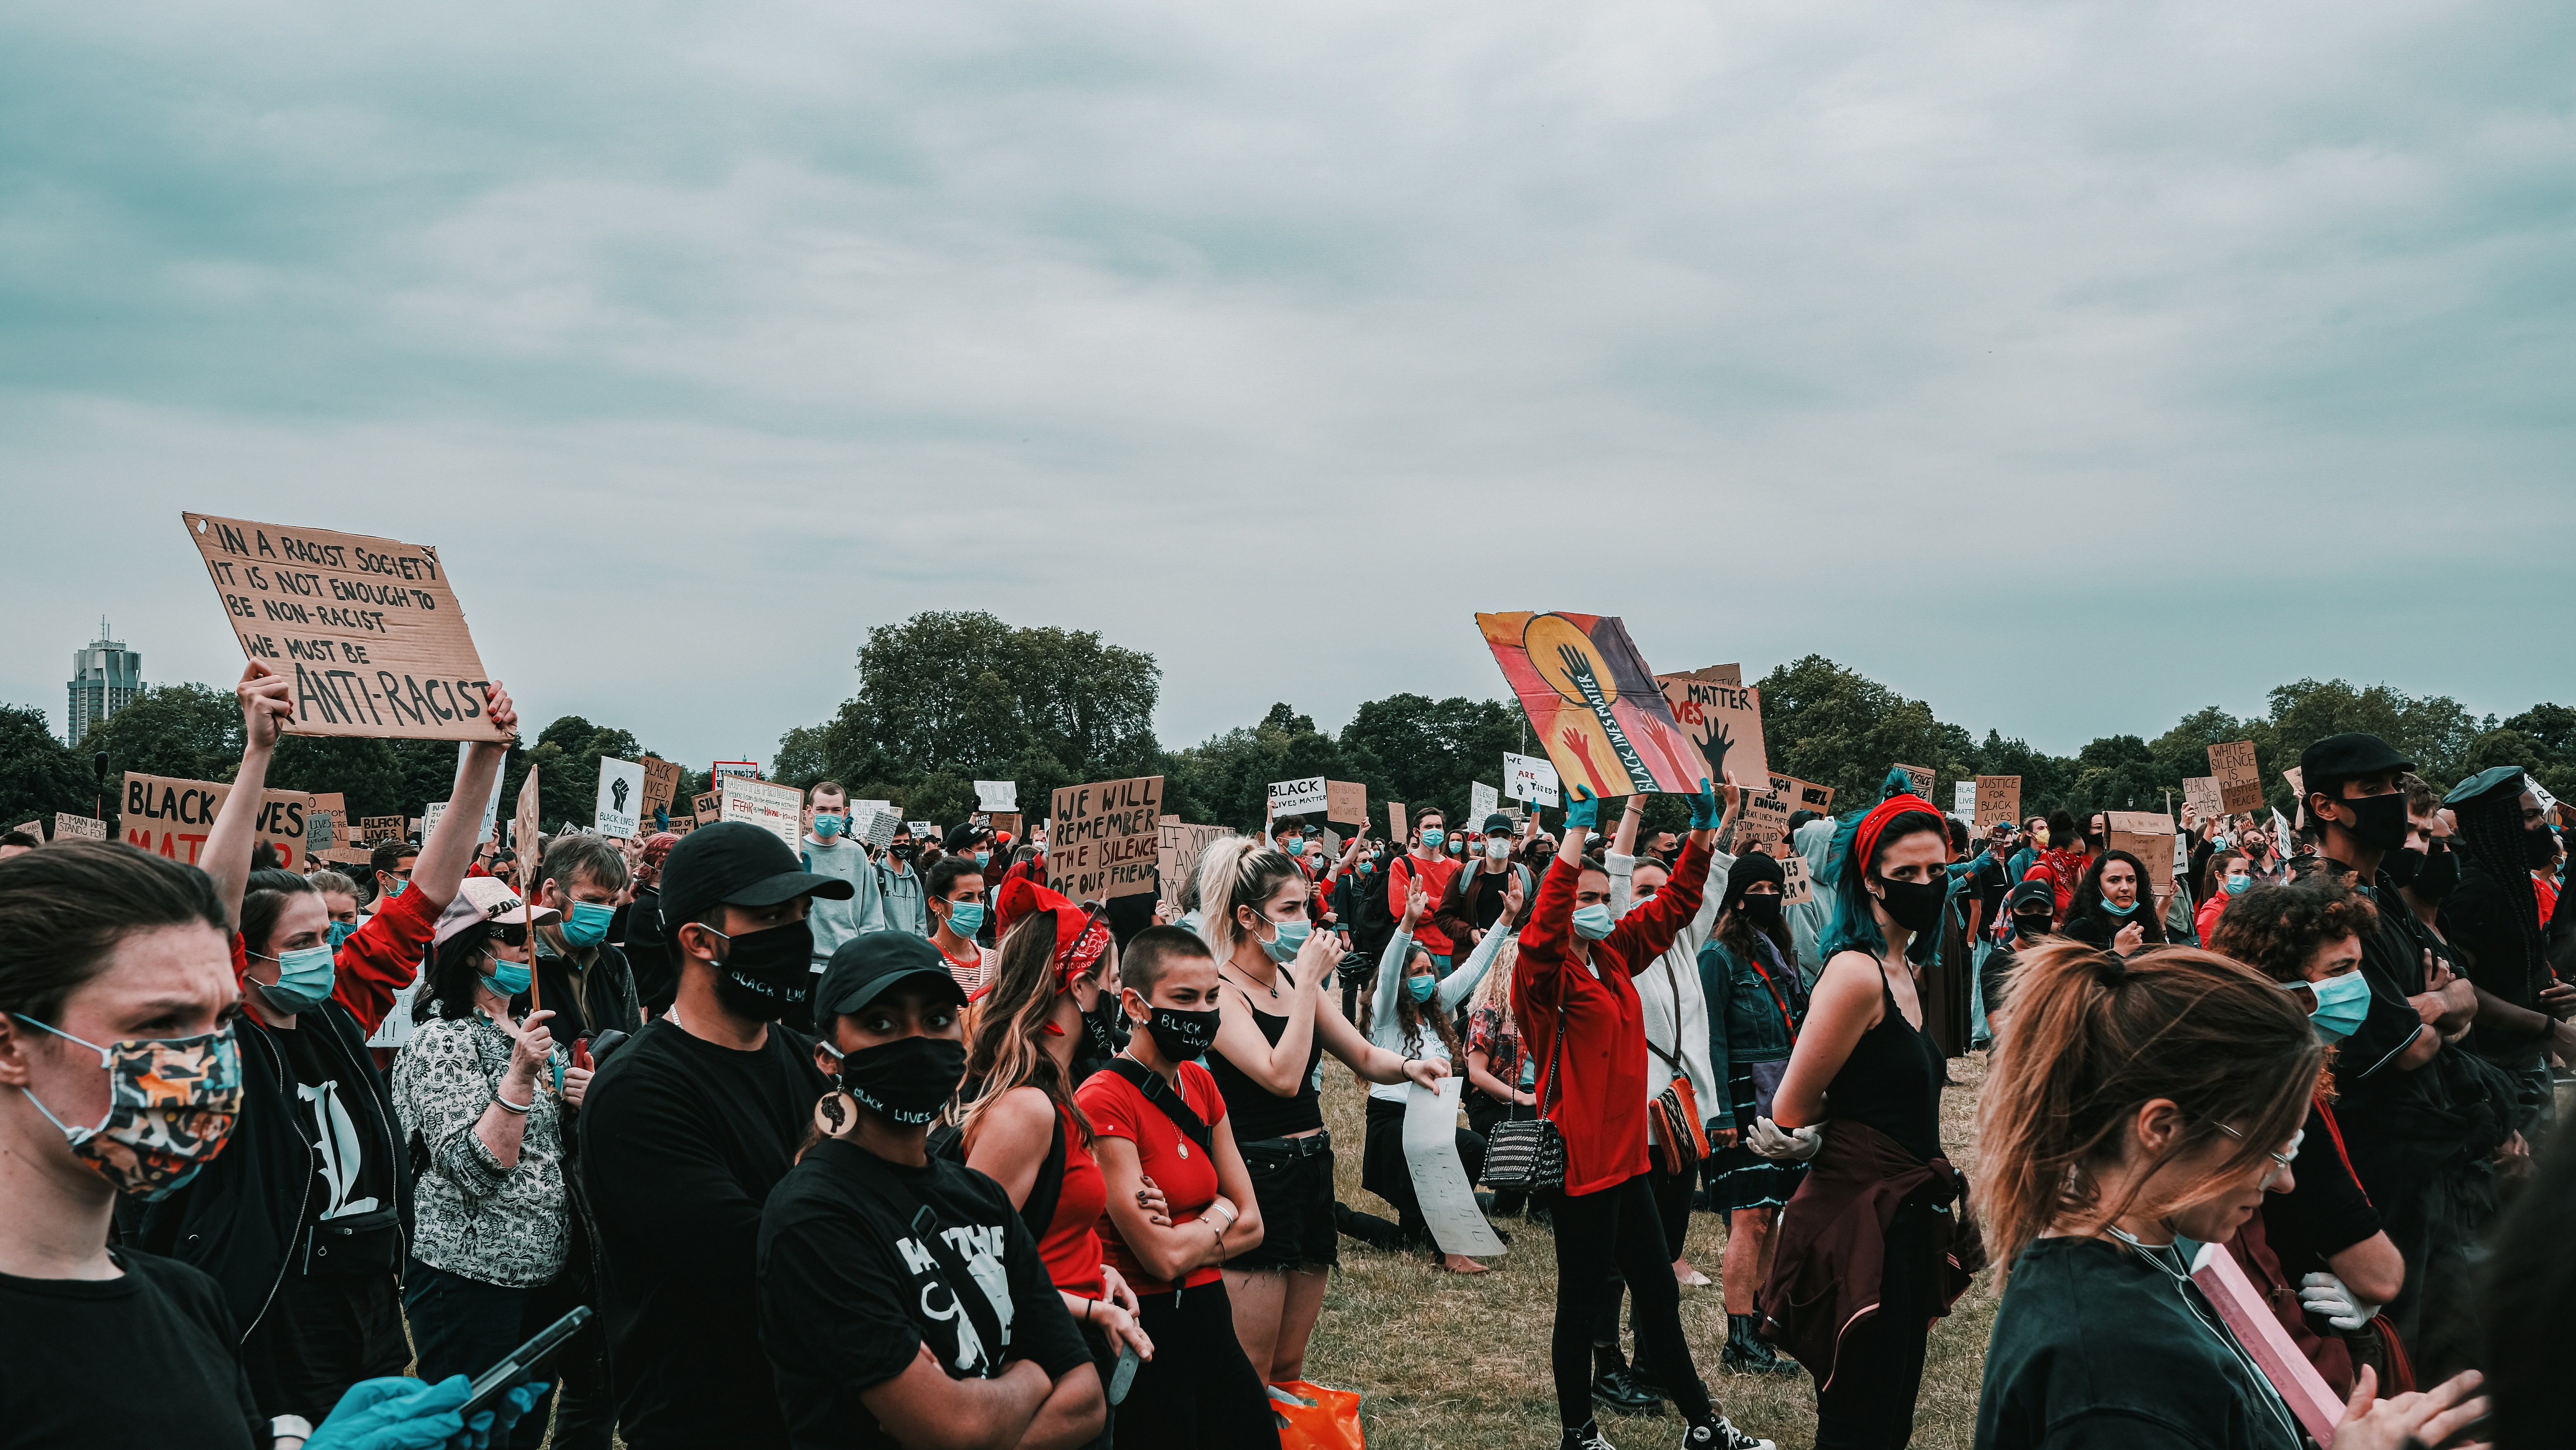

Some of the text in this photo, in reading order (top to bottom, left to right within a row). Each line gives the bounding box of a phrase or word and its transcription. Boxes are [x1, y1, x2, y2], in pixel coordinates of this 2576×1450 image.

[215, 522, 436, 581] IN A RACIST SOCIETY
[212, 560, 435, 610] IT IS NOT ENOUGH TO
[226, 594, 386, 633] BE NON-RACIST
[244, 634, 370, 664] WE MUST BE
[295, 662, 490, 726] ANTI-RACIST
[1688, 683, 1753, 711] MATTER
[1577, 673, 1660, 793] BLACK LIVES MATTER
[2213, 742, 2247, 757] WHITE
[1506, 755, 1522, 765] WE
[2211, 753, 2256, 770] SILENCE
[644, 760, 672, 782] BLACK
[1518, 770, 1535, 779] ARE
[2228, 768, 2238, 780] IS
[644, 779, 668, 798] IVES
[727, 777, 760, 794] WHITE
[1269, 780, 1319, 797] BLACK
[1328, 782, 1360, 795] PRO-BLACK
[1530, 782, 1558, 797] TIRED!
[1979, 778, 2019, 789] JUSTICE
[2184, 778, 2209, 794] BLACK
[2225, 782, 2259, 798] JUSTICE
[128, 780, 216, 825] BLACK
[308, 797, 316, 808] O
[980, 785, 1016, 805] BLM
[1057, 780, 1156, 822] WE WILL
[1299, 795, 1327, 804] MATTER
[1475, 789, 1496, 801] SILENCE
[1766, 789, 1778, 800] IS
[2198, 791, 2218, 802] LIVES
[2232, 795, 2256, 808] PEACE
[733, 799, 753, 814] FEAR
[1329, 807, 1358, 816] ANTI-WHITE
[1754, 797, 1787, 813] ENOUGH
[1981, 801, 2012, 811] BLACK
[2193, 797, 2223, 814] ATTER!
[599, 812, 635, 826] BLACK LIVES
[1507, 809, 1520, 818] LIVES
[1745, 809, 1757, 819] BLACK
[1984, 812, 2015, 823] LIVES!
[27, 822, 40, 832] MANY
[57, 822, 88, 836] STANDS
[90, 829, 105, 839] FOR
[58, 814, 107, 831] A MAN WHO
[310, 818, 331, 830] LIVES
[364, 817, 402, 829] BLACK
[603, 824, 629, 835] MATTER
[1056, 808, 1155, 847] REMEMBER
[1739, 821, 1754, 832] STOP
[364, 829, 397, 839] LIVES
[1158, 825, 1184, 849] IF
[1763, 833, 1778, 842] LIVES
[1052, 838, 1158, 873] THE SILENCE
[1050, 863, 1155, 897] OF OUR FRIENDS
[731, 970, 774, 997] BLACK
[1161, 1014, 1201, 1034] BLACK
[853, 1086, 930, 1124] BLACK LIVES
